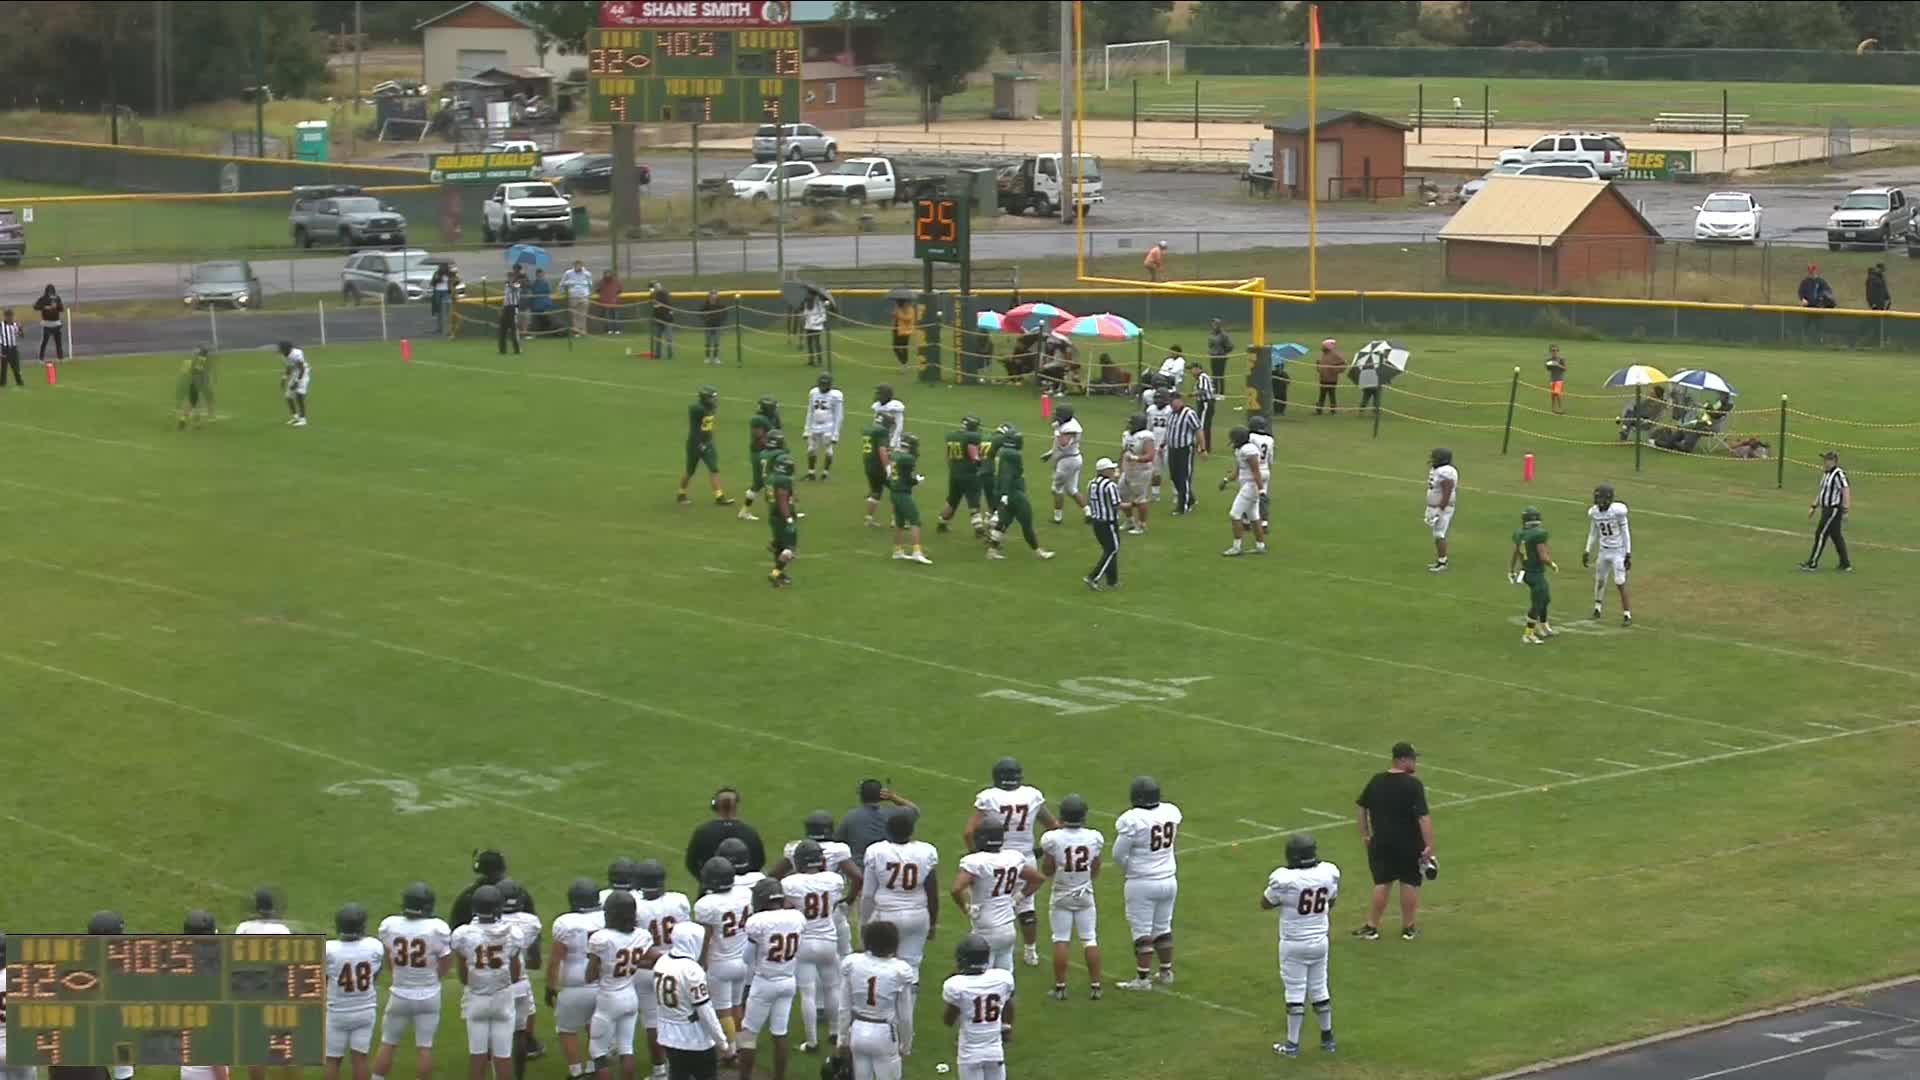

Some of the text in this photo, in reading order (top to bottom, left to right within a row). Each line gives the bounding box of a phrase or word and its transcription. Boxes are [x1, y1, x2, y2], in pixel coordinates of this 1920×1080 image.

[642, 2, 750, 17] SHANE SMITH
[591, 49, 624, 73] 32
[775, 49, 800, 74] 13
[610, 97, 625, 121] 4
[763, 99, 779, 119] 4
[488, 152, 537, 168] EAGLES
[1627, 152, 1665, 169] GLES
[916, 200, 957, 241] 25
[1599, 522, 1615, 536] 21
[1001, 804, 1029, 831] 77
[1150, 821, 1175, 852] 69
[1064, 845, 1089, 873] 12
[886, 862, 919, 891] 70
[991, 866, 1018, 898] 78
[804, 890, 830, 920] 81
[1297, 887, 1328, 915] 66
[721, 905, 751, 938] 24
[393, 936, 427, 968] 32
[475, 943, 503, 969] 15
[767, 932, 799, 963] 20
[613, 947, 645, 978] 29
[337, 961, 371, 993] 48
[653, 971, 679, 1009] 78
[866, 975, 877, 1007] 1
[690, 983, 708, 1000] 78
[972, 993, 1001, 1024] 16
